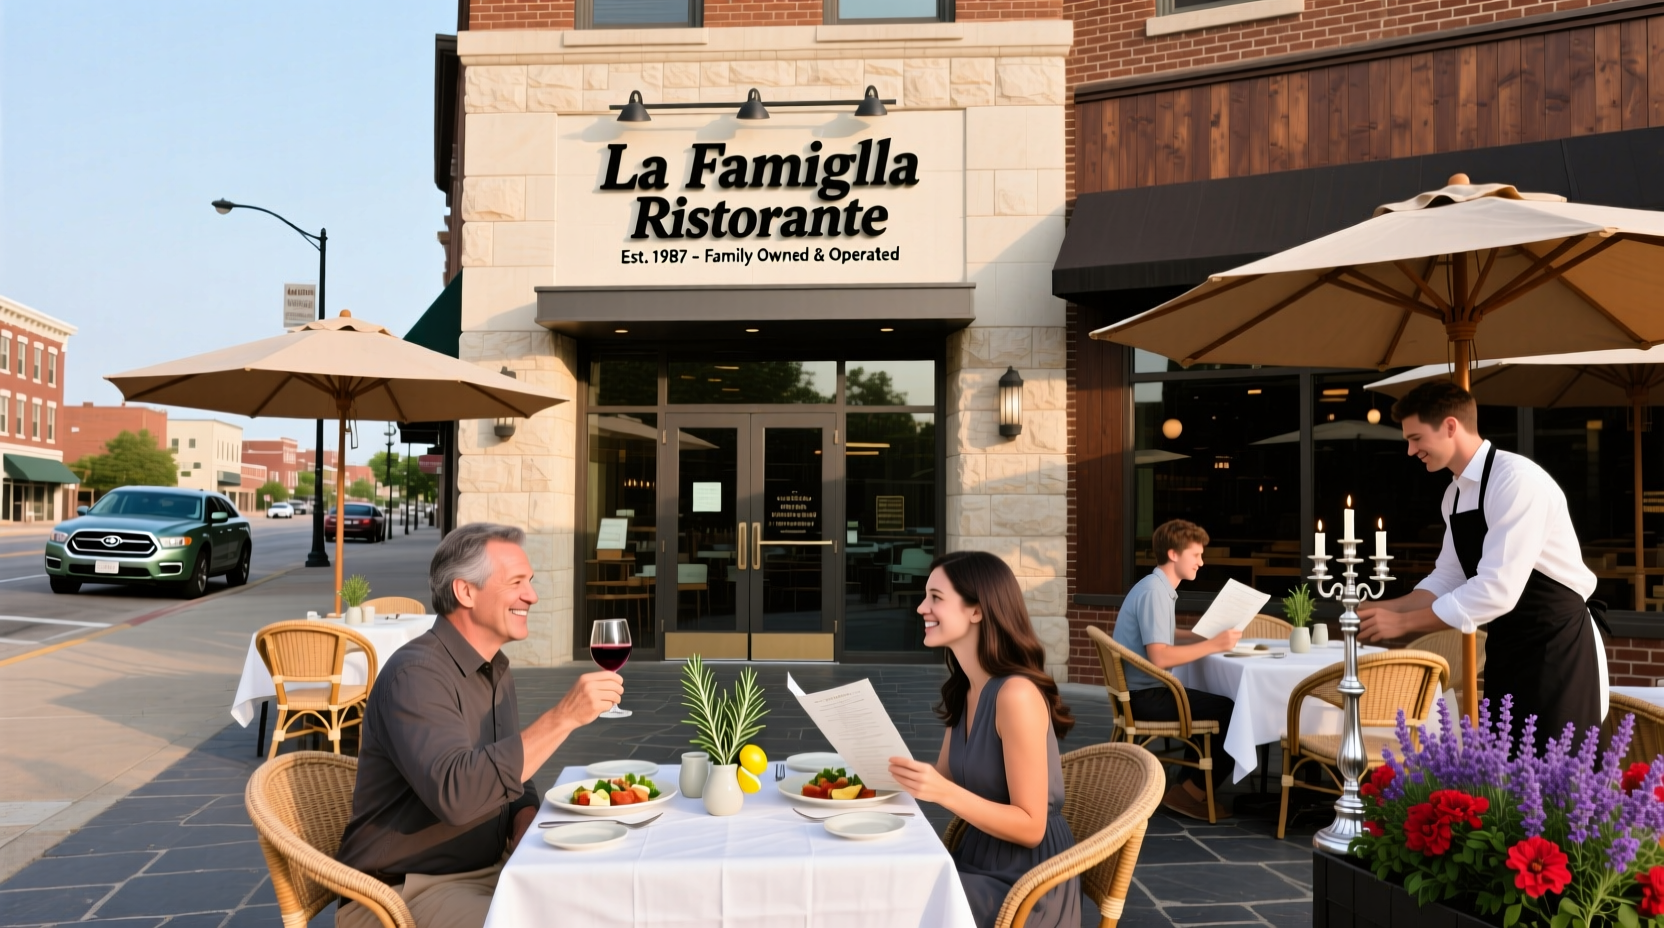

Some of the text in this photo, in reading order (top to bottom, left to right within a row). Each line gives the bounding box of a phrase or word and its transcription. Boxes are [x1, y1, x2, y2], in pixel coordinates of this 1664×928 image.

[599, 137, 920, 203] La Famiglla
[630, 195, 889, 241] Ristorante
[621, 249, 649, 265] Est.
[652, 249, 688, 264] 1987
[705, 247, 754, 267] Family
[757, 246, 809, 263] Owned
[813, 247, 825, 262] &
[828, 245, 900, 265] Operated
